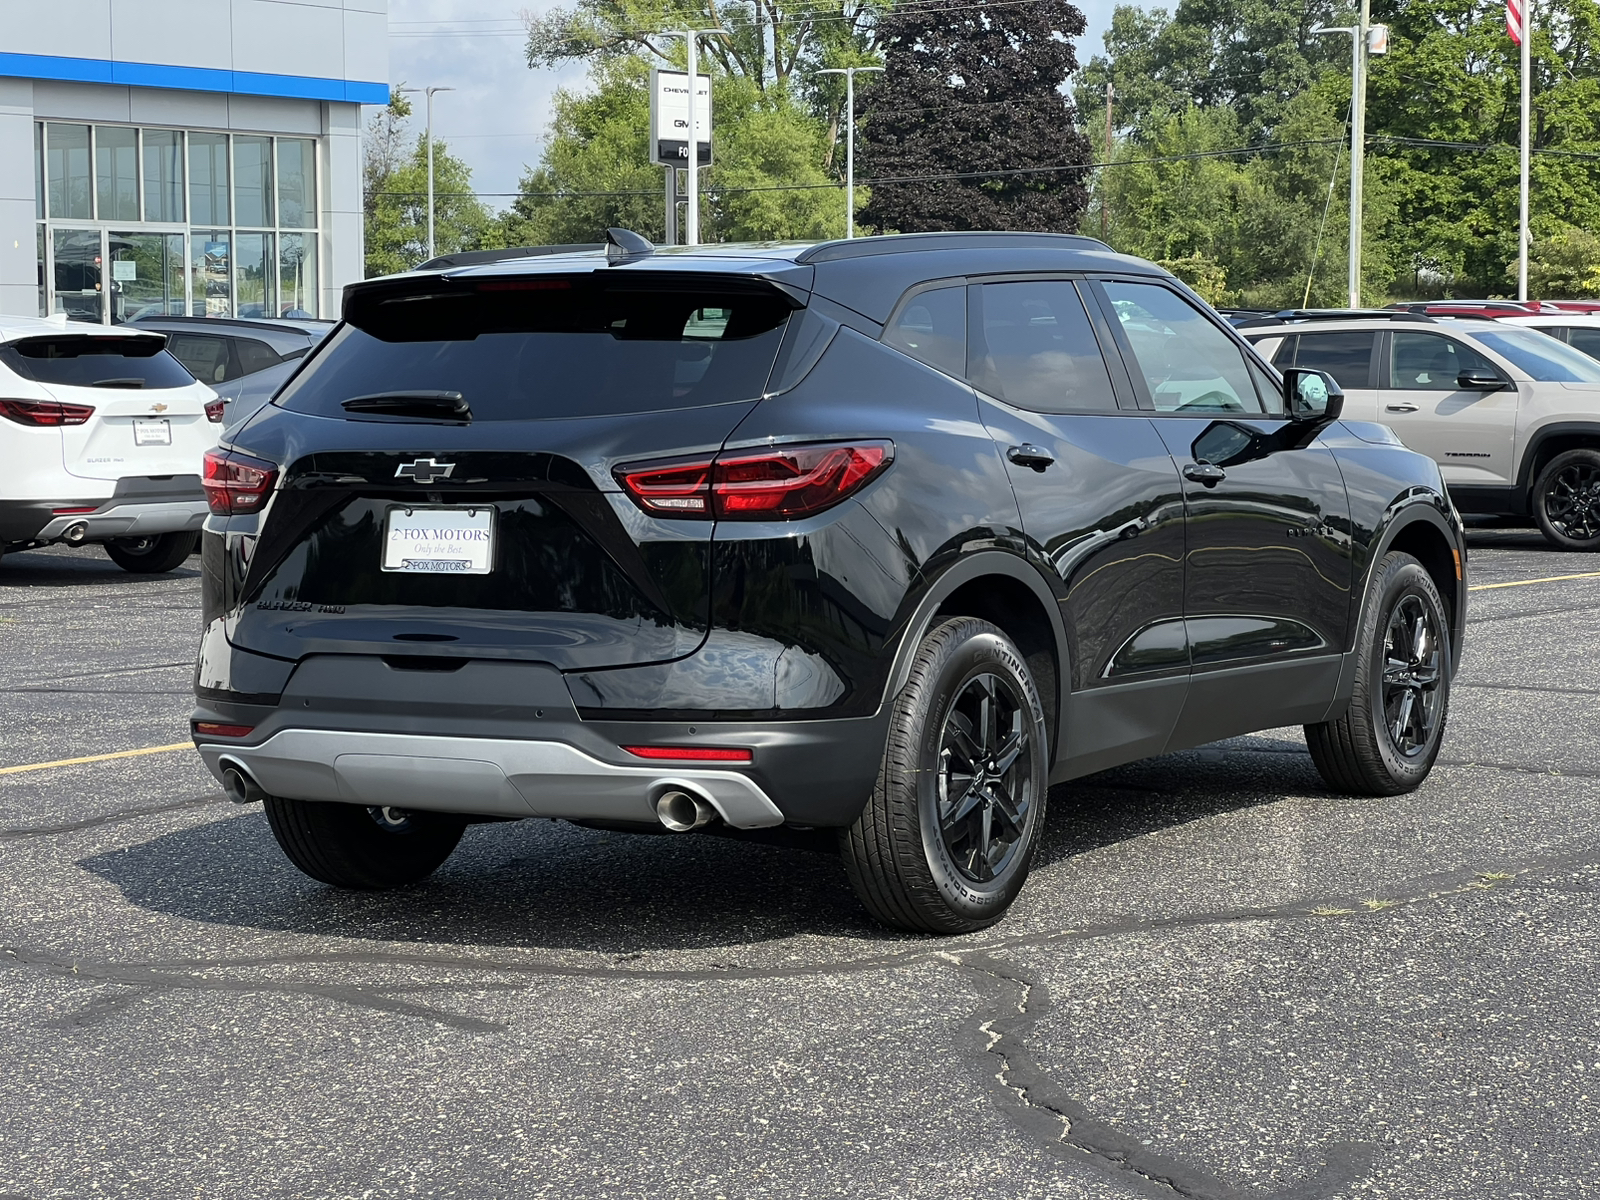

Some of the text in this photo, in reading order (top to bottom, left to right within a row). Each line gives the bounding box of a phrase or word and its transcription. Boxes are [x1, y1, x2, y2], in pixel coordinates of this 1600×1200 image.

[678, 146, 689, 157] FO
[404, 528, 490, 541] FOX MOTORS
[1286, 526, 1334, 538] BLAZER
[414, 543, 433, 556] Only
[433, 544, 446, 553] the
[413, 561, 467, 571] FOX MOTORS
[257, 601, 313, 612] BLAZER
